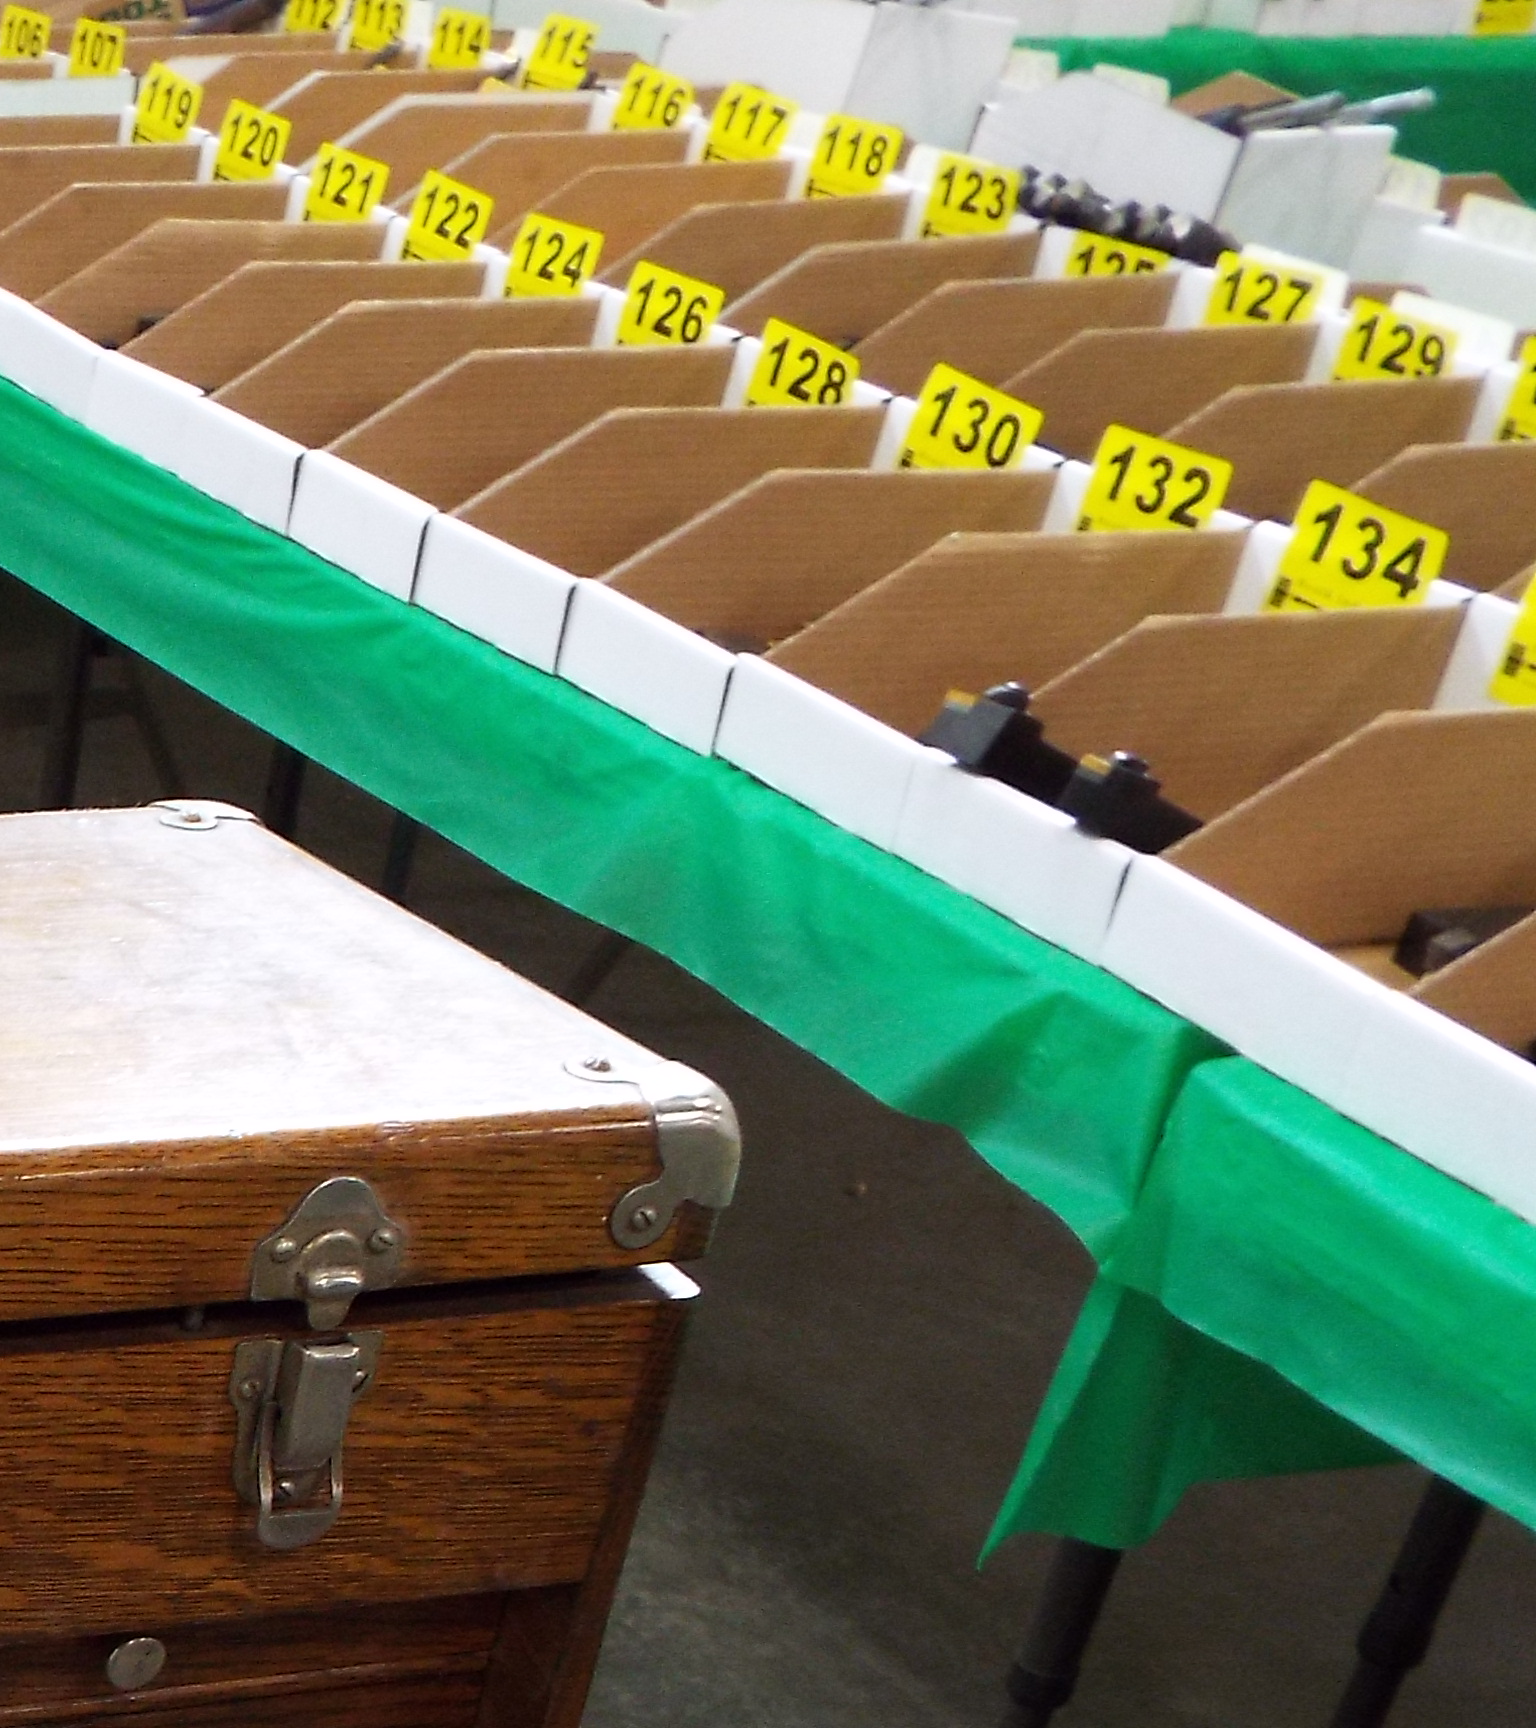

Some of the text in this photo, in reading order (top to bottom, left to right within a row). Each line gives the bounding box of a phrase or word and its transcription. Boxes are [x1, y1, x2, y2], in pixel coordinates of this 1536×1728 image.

[6, 18, 43, 58] 106
[78, 28, 118, 69] 107
[439, 21, 483, 54] 114
[544, 24, 594, 67] 115
[148, 73, 194, 130] 119
[628, 74, 681, 127] 116
[725, 98, 788, 147] 117
[229, 113, 279, 168] 120
[823, 126, 887, 179] 118
[317, 157, 375, 214] 121
[939, 165, 1008, 221] 123
[422, 183, 481, 247] 122
[521, 225, 588, 288] 124
[635, 277, 710, 344] 126
[1223, 266, 1314, 323] 127
[766, 338, 848, 405] 128
[1357, 315, 1446, 377] 129
[930, 385, 1023, 468] 130
[1105, 445, 1212, 530] 132
[1311, 503, 1427, 600] 134
